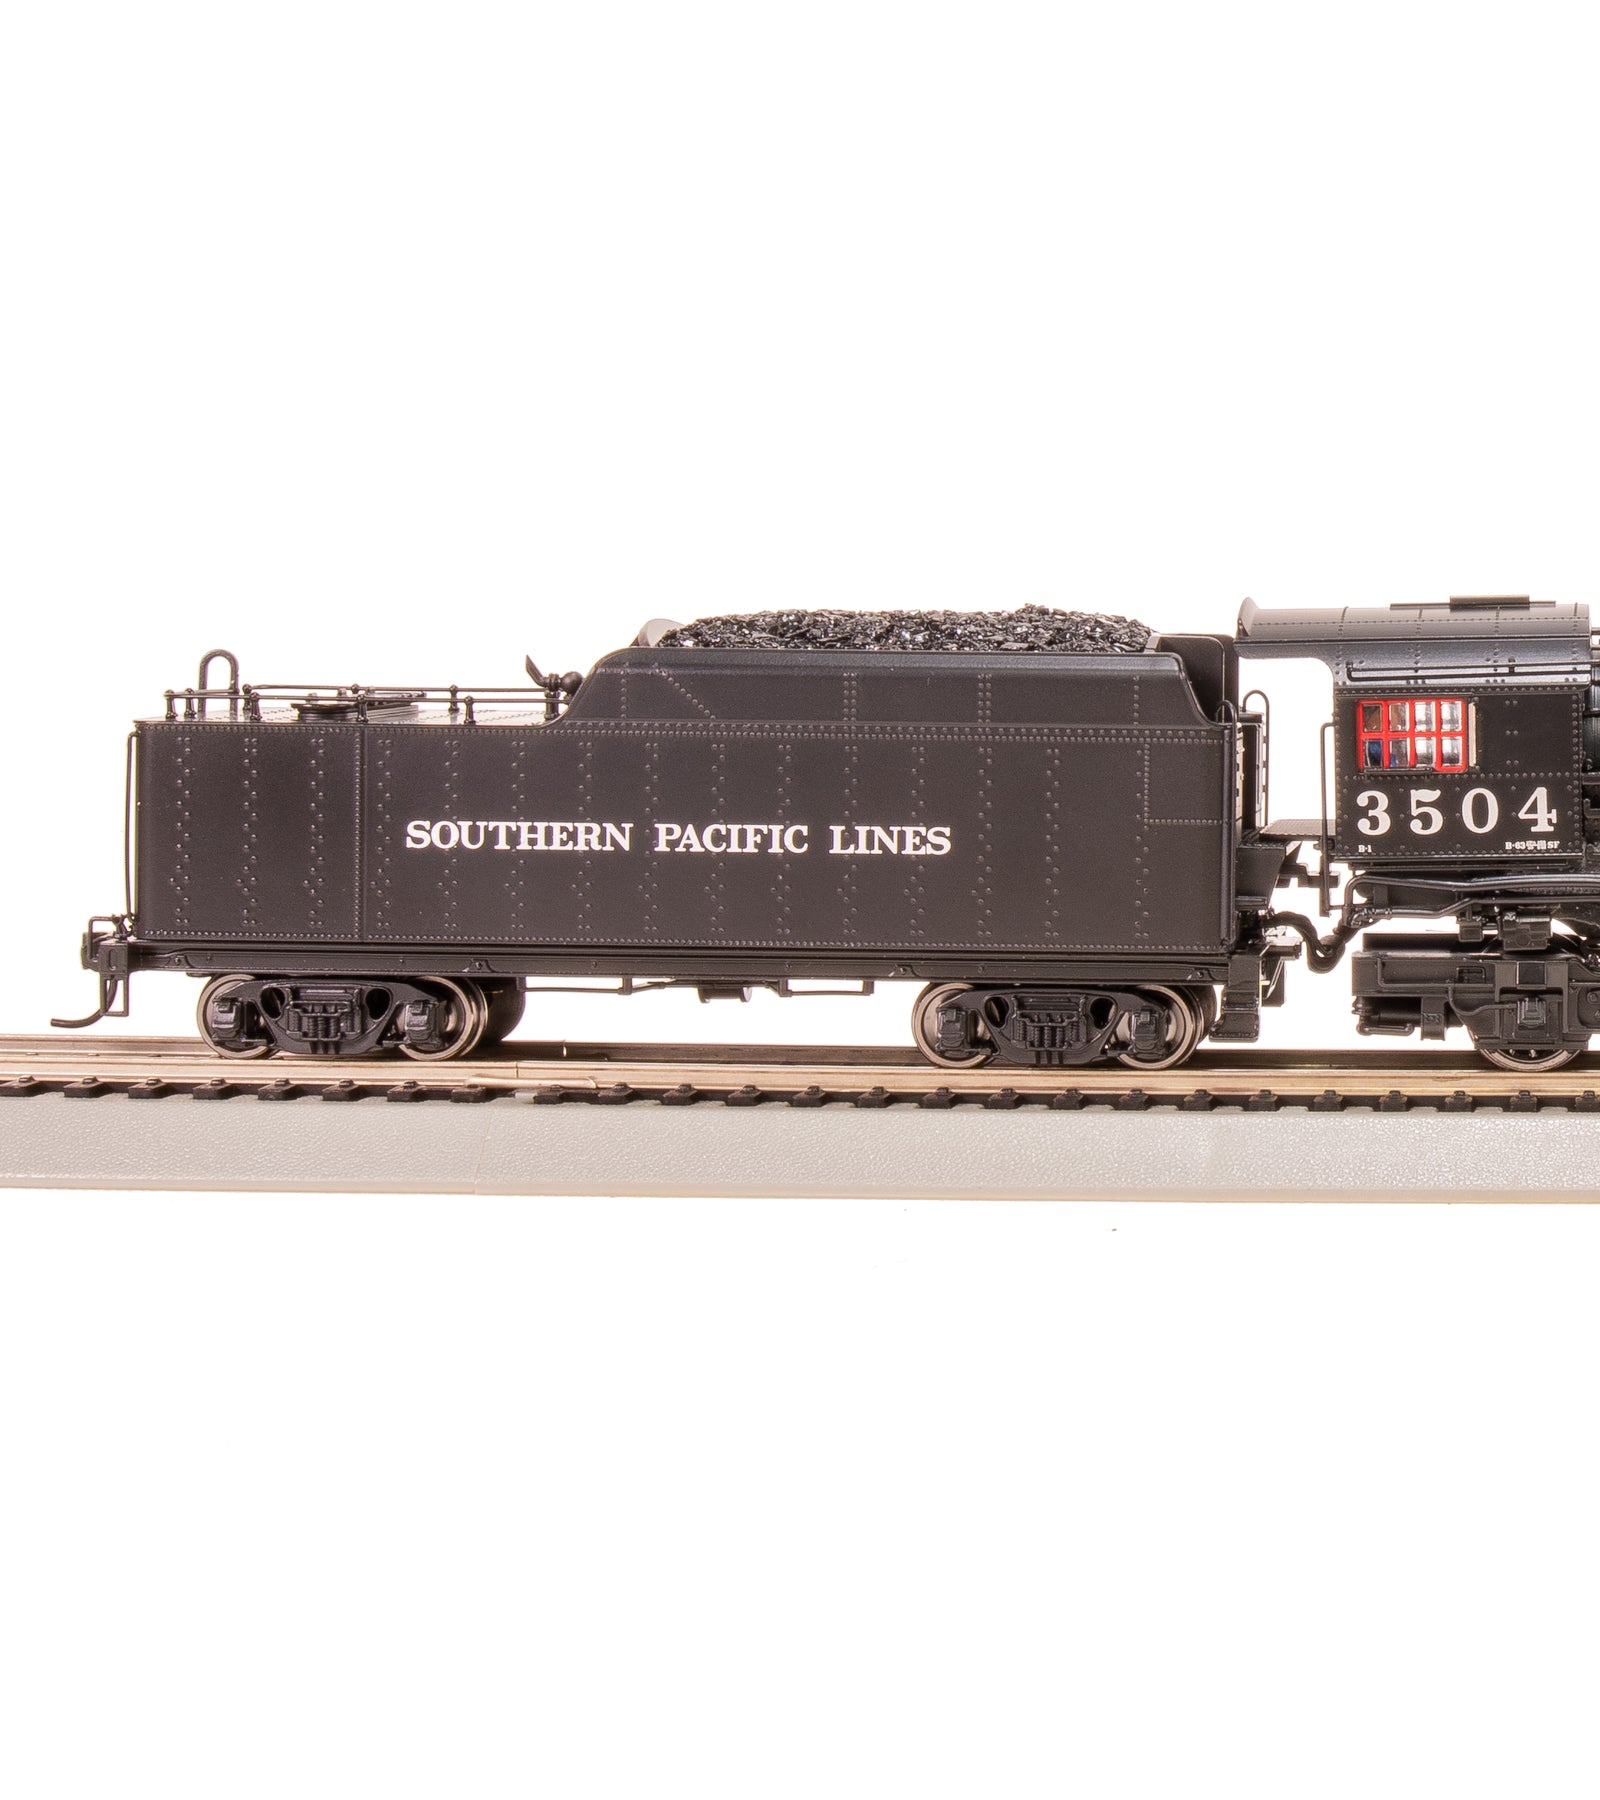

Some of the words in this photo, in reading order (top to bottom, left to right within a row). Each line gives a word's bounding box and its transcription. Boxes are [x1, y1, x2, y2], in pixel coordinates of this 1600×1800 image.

[1356, 786, 1558, 836] 3504
[405, 820, 634, 851] SOUTHERN
[654, 822, 808, 854] PACIFIC
[829, 825, 951, 855] LINES
